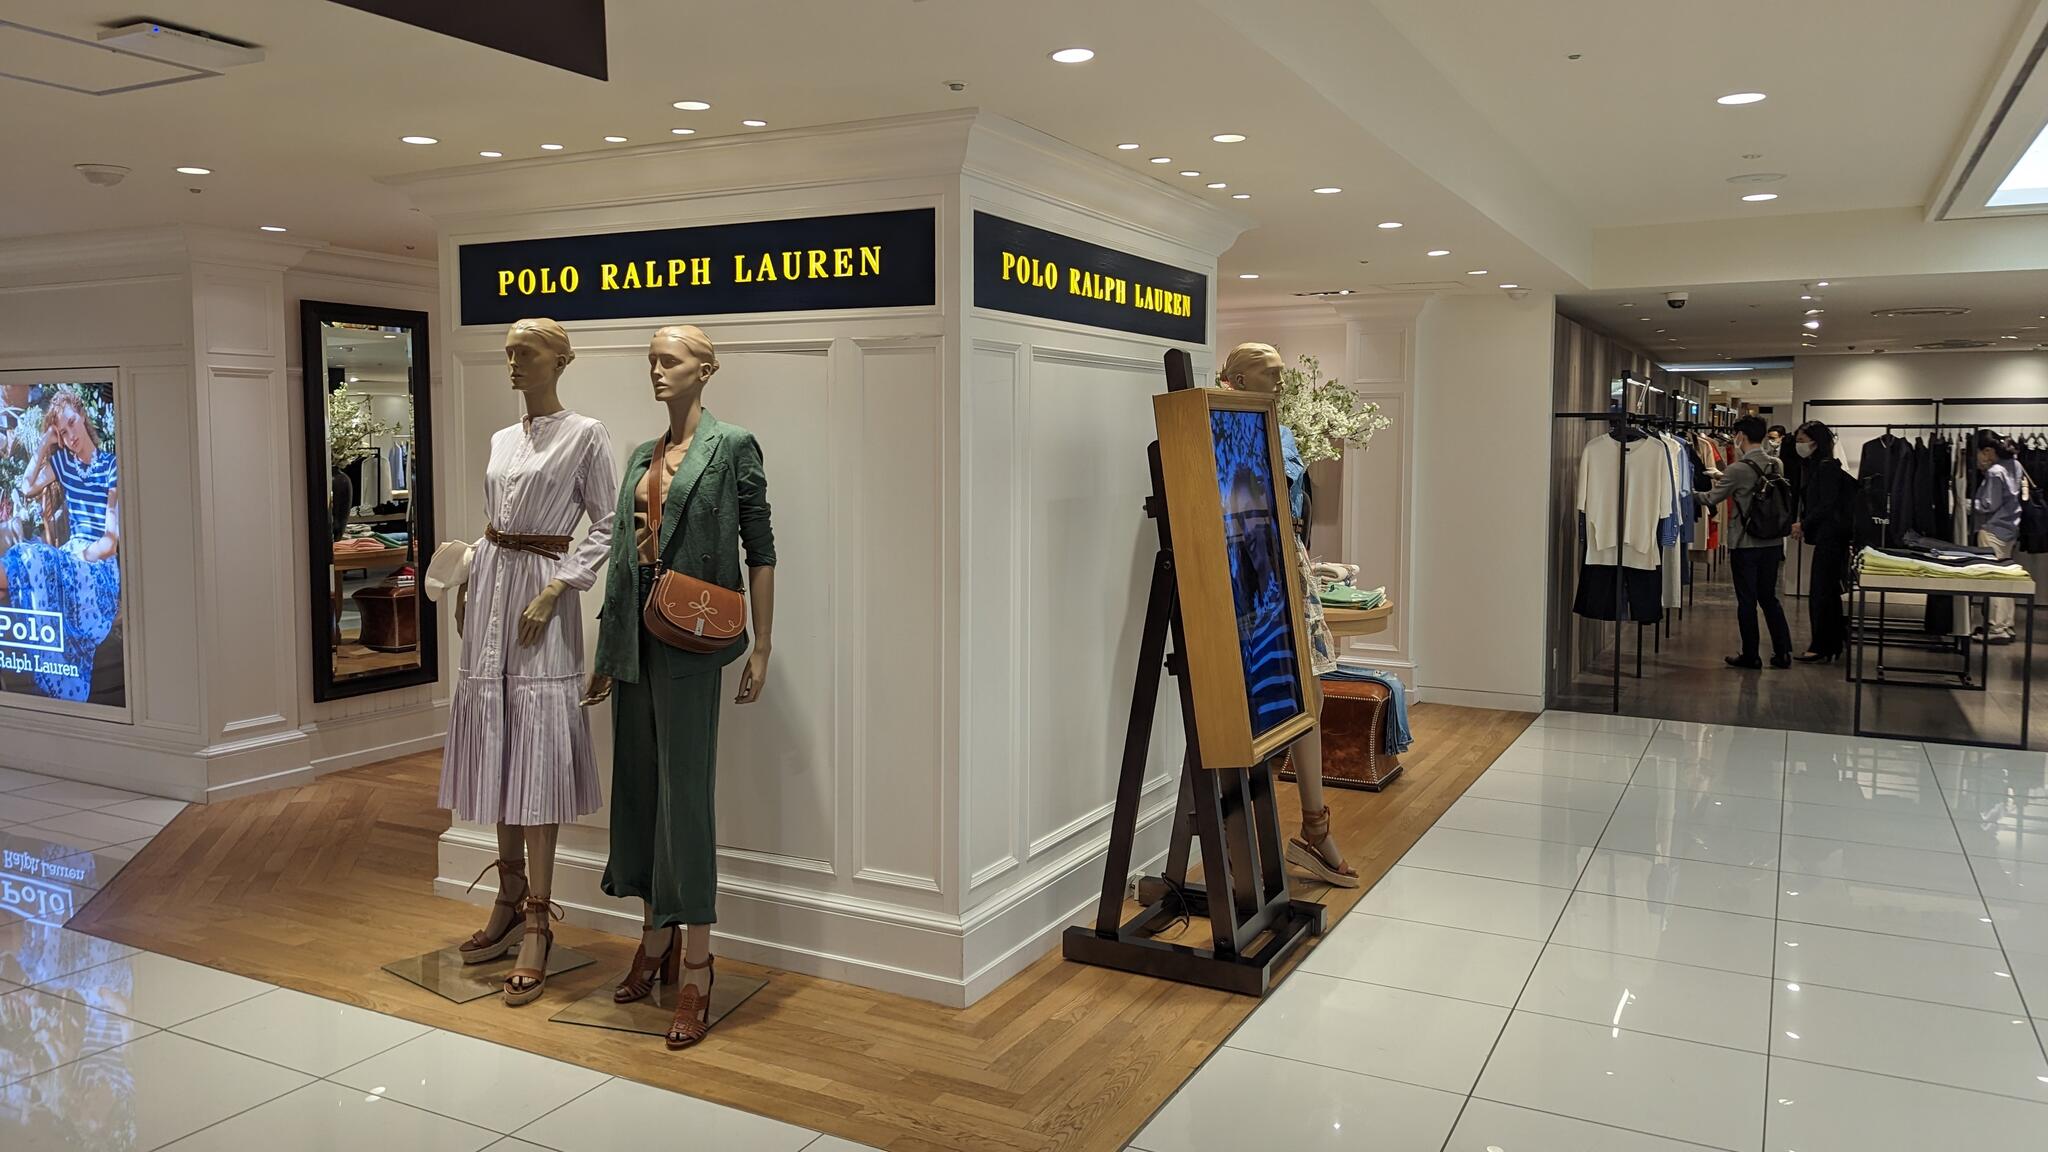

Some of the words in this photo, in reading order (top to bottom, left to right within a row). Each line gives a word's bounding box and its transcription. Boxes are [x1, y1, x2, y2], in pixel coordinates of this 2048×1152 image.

[498, 265, 580, 296] POLO
[601, 257, 711, 291] RALPH
[734, 245, 883, 283] LAUREN
[1001, 251, 1058, 290] POLO
[1069, 267, 1127, 305] RALPH
[1134, 283, 1191, 318] LAUREN
[0, 614, 56, 643] Polo
[33, 654, 79, 677] Lauren
